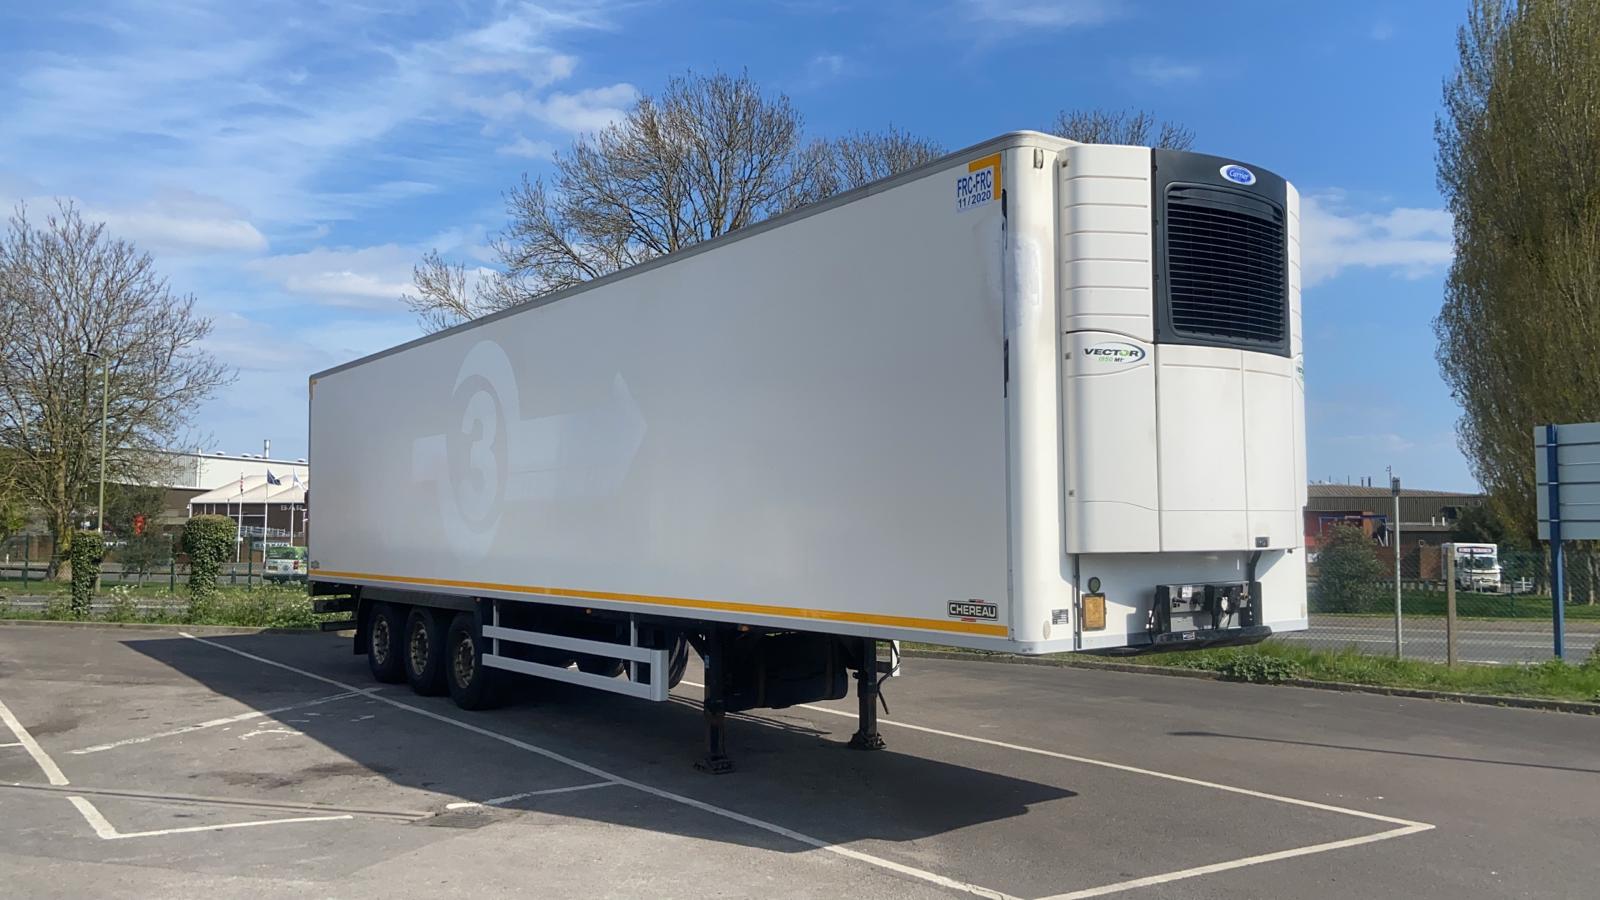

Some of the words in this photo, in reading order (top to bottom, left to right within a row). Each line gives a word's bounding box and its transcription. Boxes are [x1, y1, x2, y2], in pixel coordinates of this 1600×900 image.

[958, 190, 992, 208] 11/2020
[1084, 348, 1139, 357] VECTOR
[949, 603, 997, 617] CHEREAU
